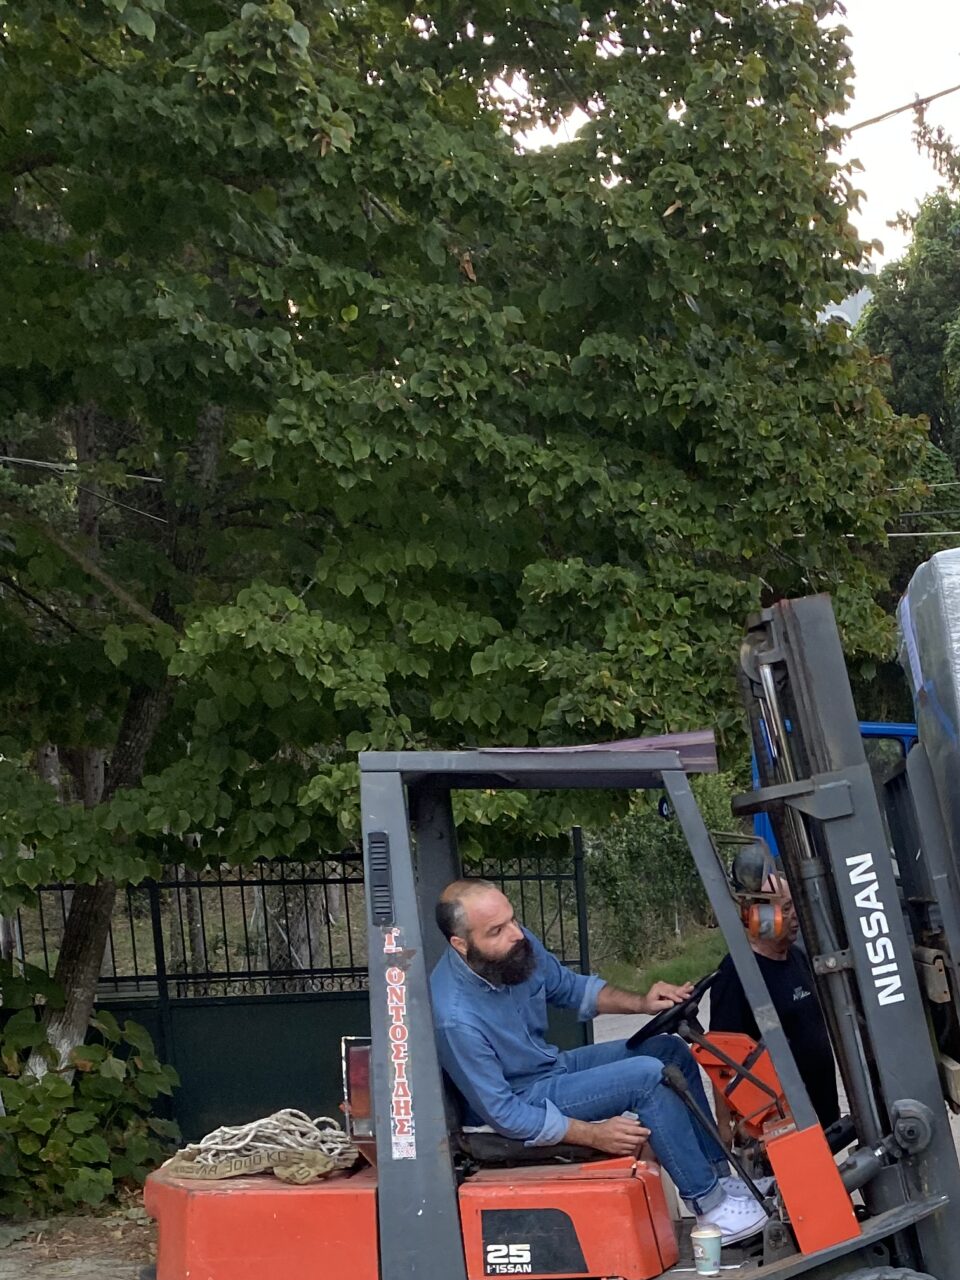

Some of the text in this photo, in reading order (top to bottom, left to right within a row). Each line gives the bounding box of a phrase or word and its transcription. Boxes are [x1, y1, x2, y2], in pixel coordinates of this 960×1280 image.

[846, 853, 905, 1006] NISSAN
[383, 928, 413, 1136] ΓΟΝΤΟΣΙΔΗΣ
[486, 1244, 531, 1264] 25
